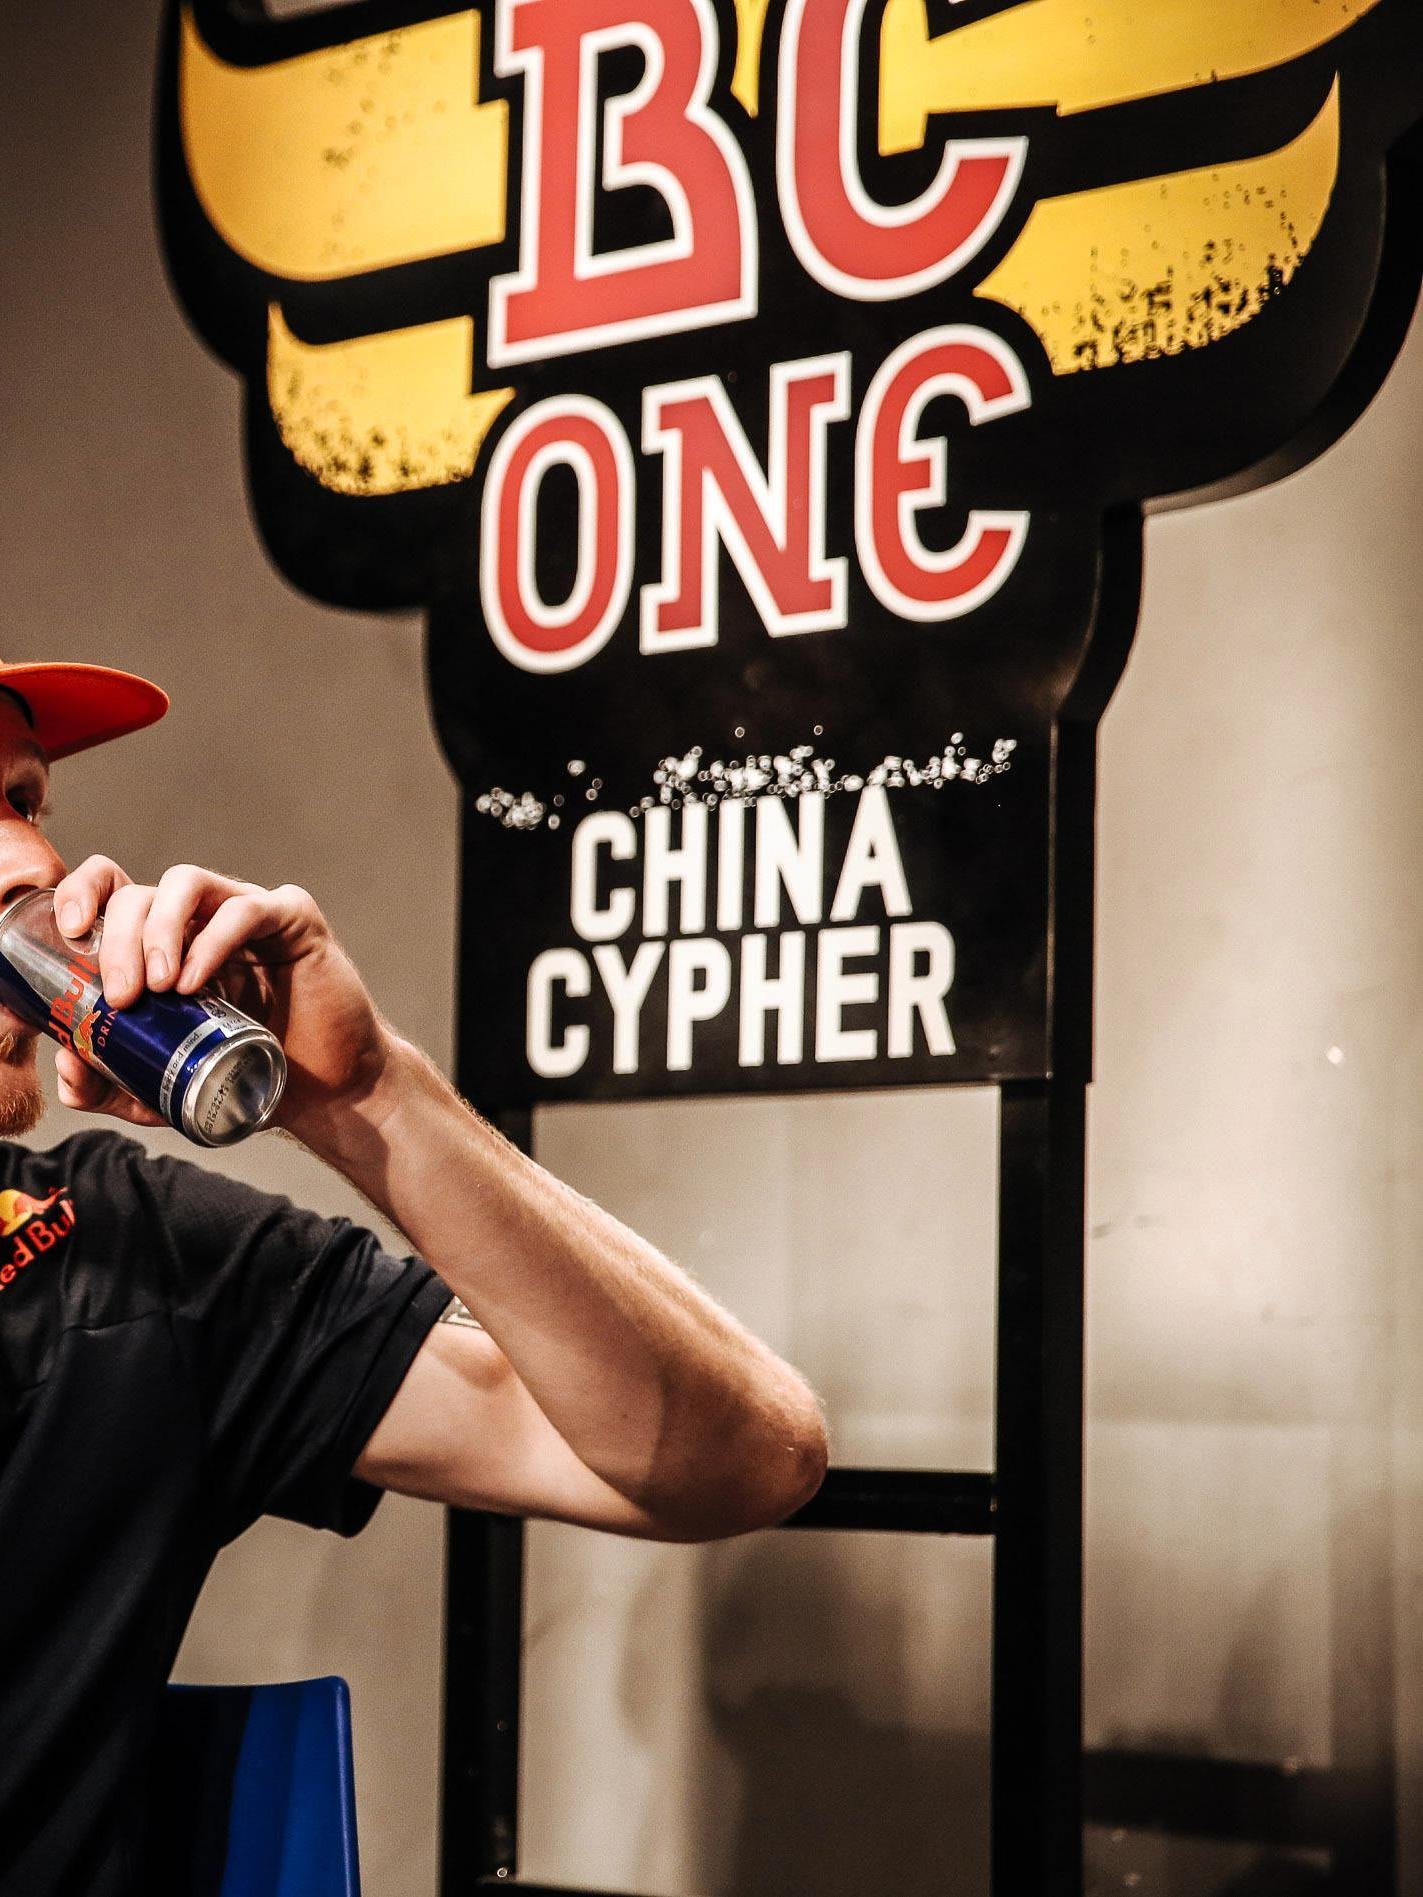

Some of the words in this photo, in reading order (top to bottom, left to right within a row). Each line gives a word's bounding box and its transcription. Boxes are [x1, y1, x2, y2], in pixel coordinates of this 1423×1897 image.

[487, 0, 1029, 368] BC
[480, 324, 1032, 674] ONE
[571, 785, 913, 942] CHINA
[97, 1009, 119, 1048] DRIN
[526, 921, 957, 1078] CYPHER
[26, 1199, 76, 1253] Bul
